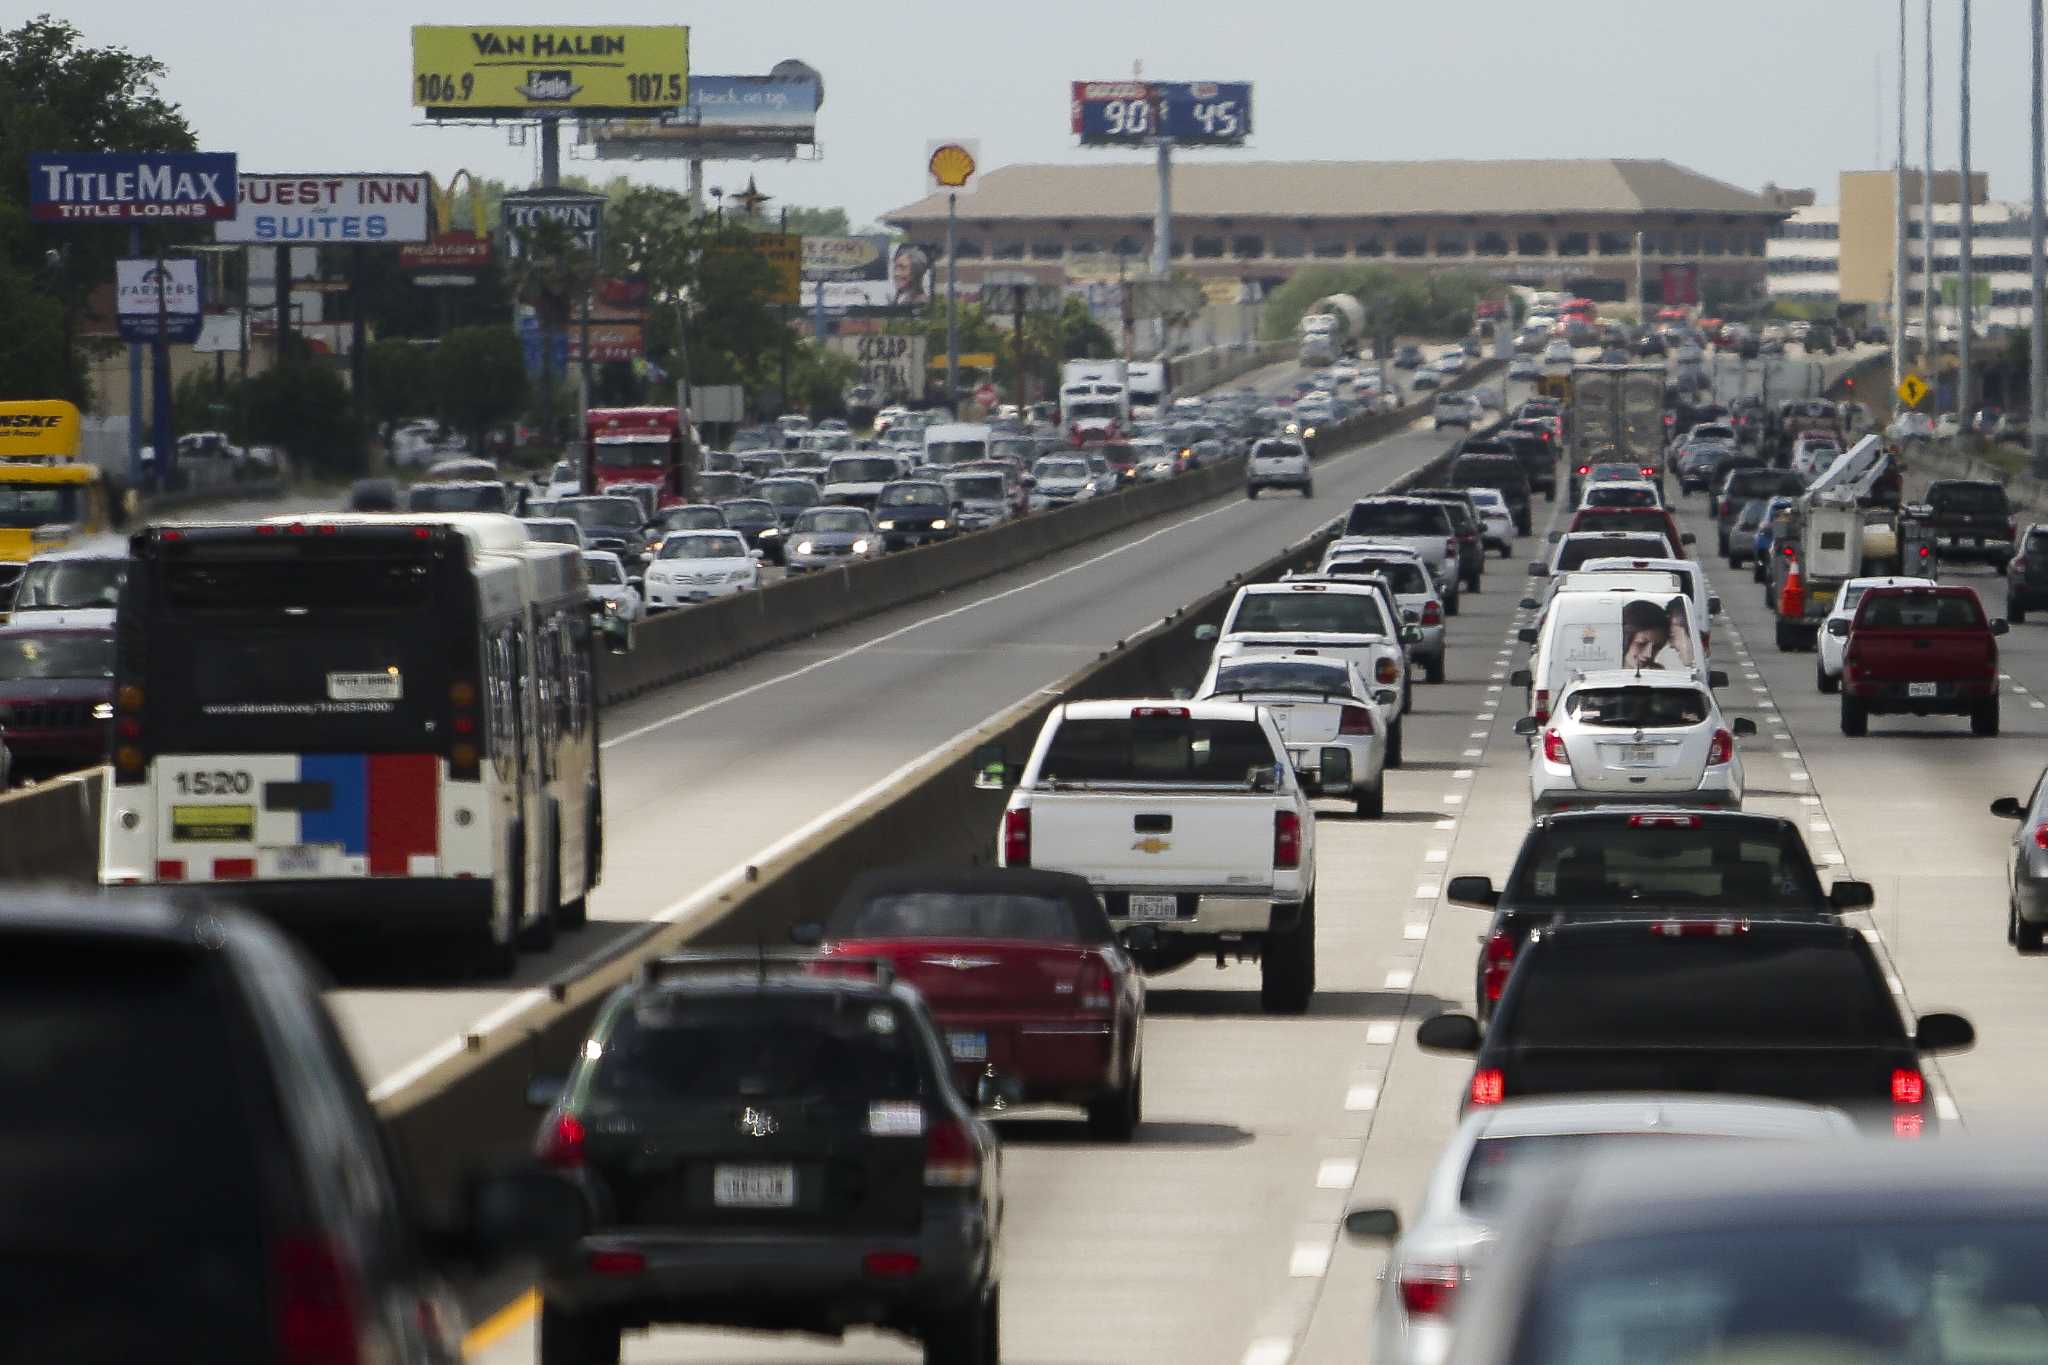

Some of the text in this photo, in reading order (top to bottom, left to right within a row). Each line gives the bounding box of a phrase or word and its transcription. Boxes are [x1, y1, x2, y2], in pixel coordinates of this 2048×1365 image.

[472, 33, 625, 57] VAN HALEN
[417, 72, 475, 102] 106.9
[627, 73, 682, 102] 107.5
[1104, 100, 1149, 135] 90
[1193, 101, 1239, 137] 45
[358, 181, 420, 205] INN
[59, 204, 208, 217] TITLE LOANS
[254, 215, 389, 240] SUITES
[174, 770, 255, 795] 1520
